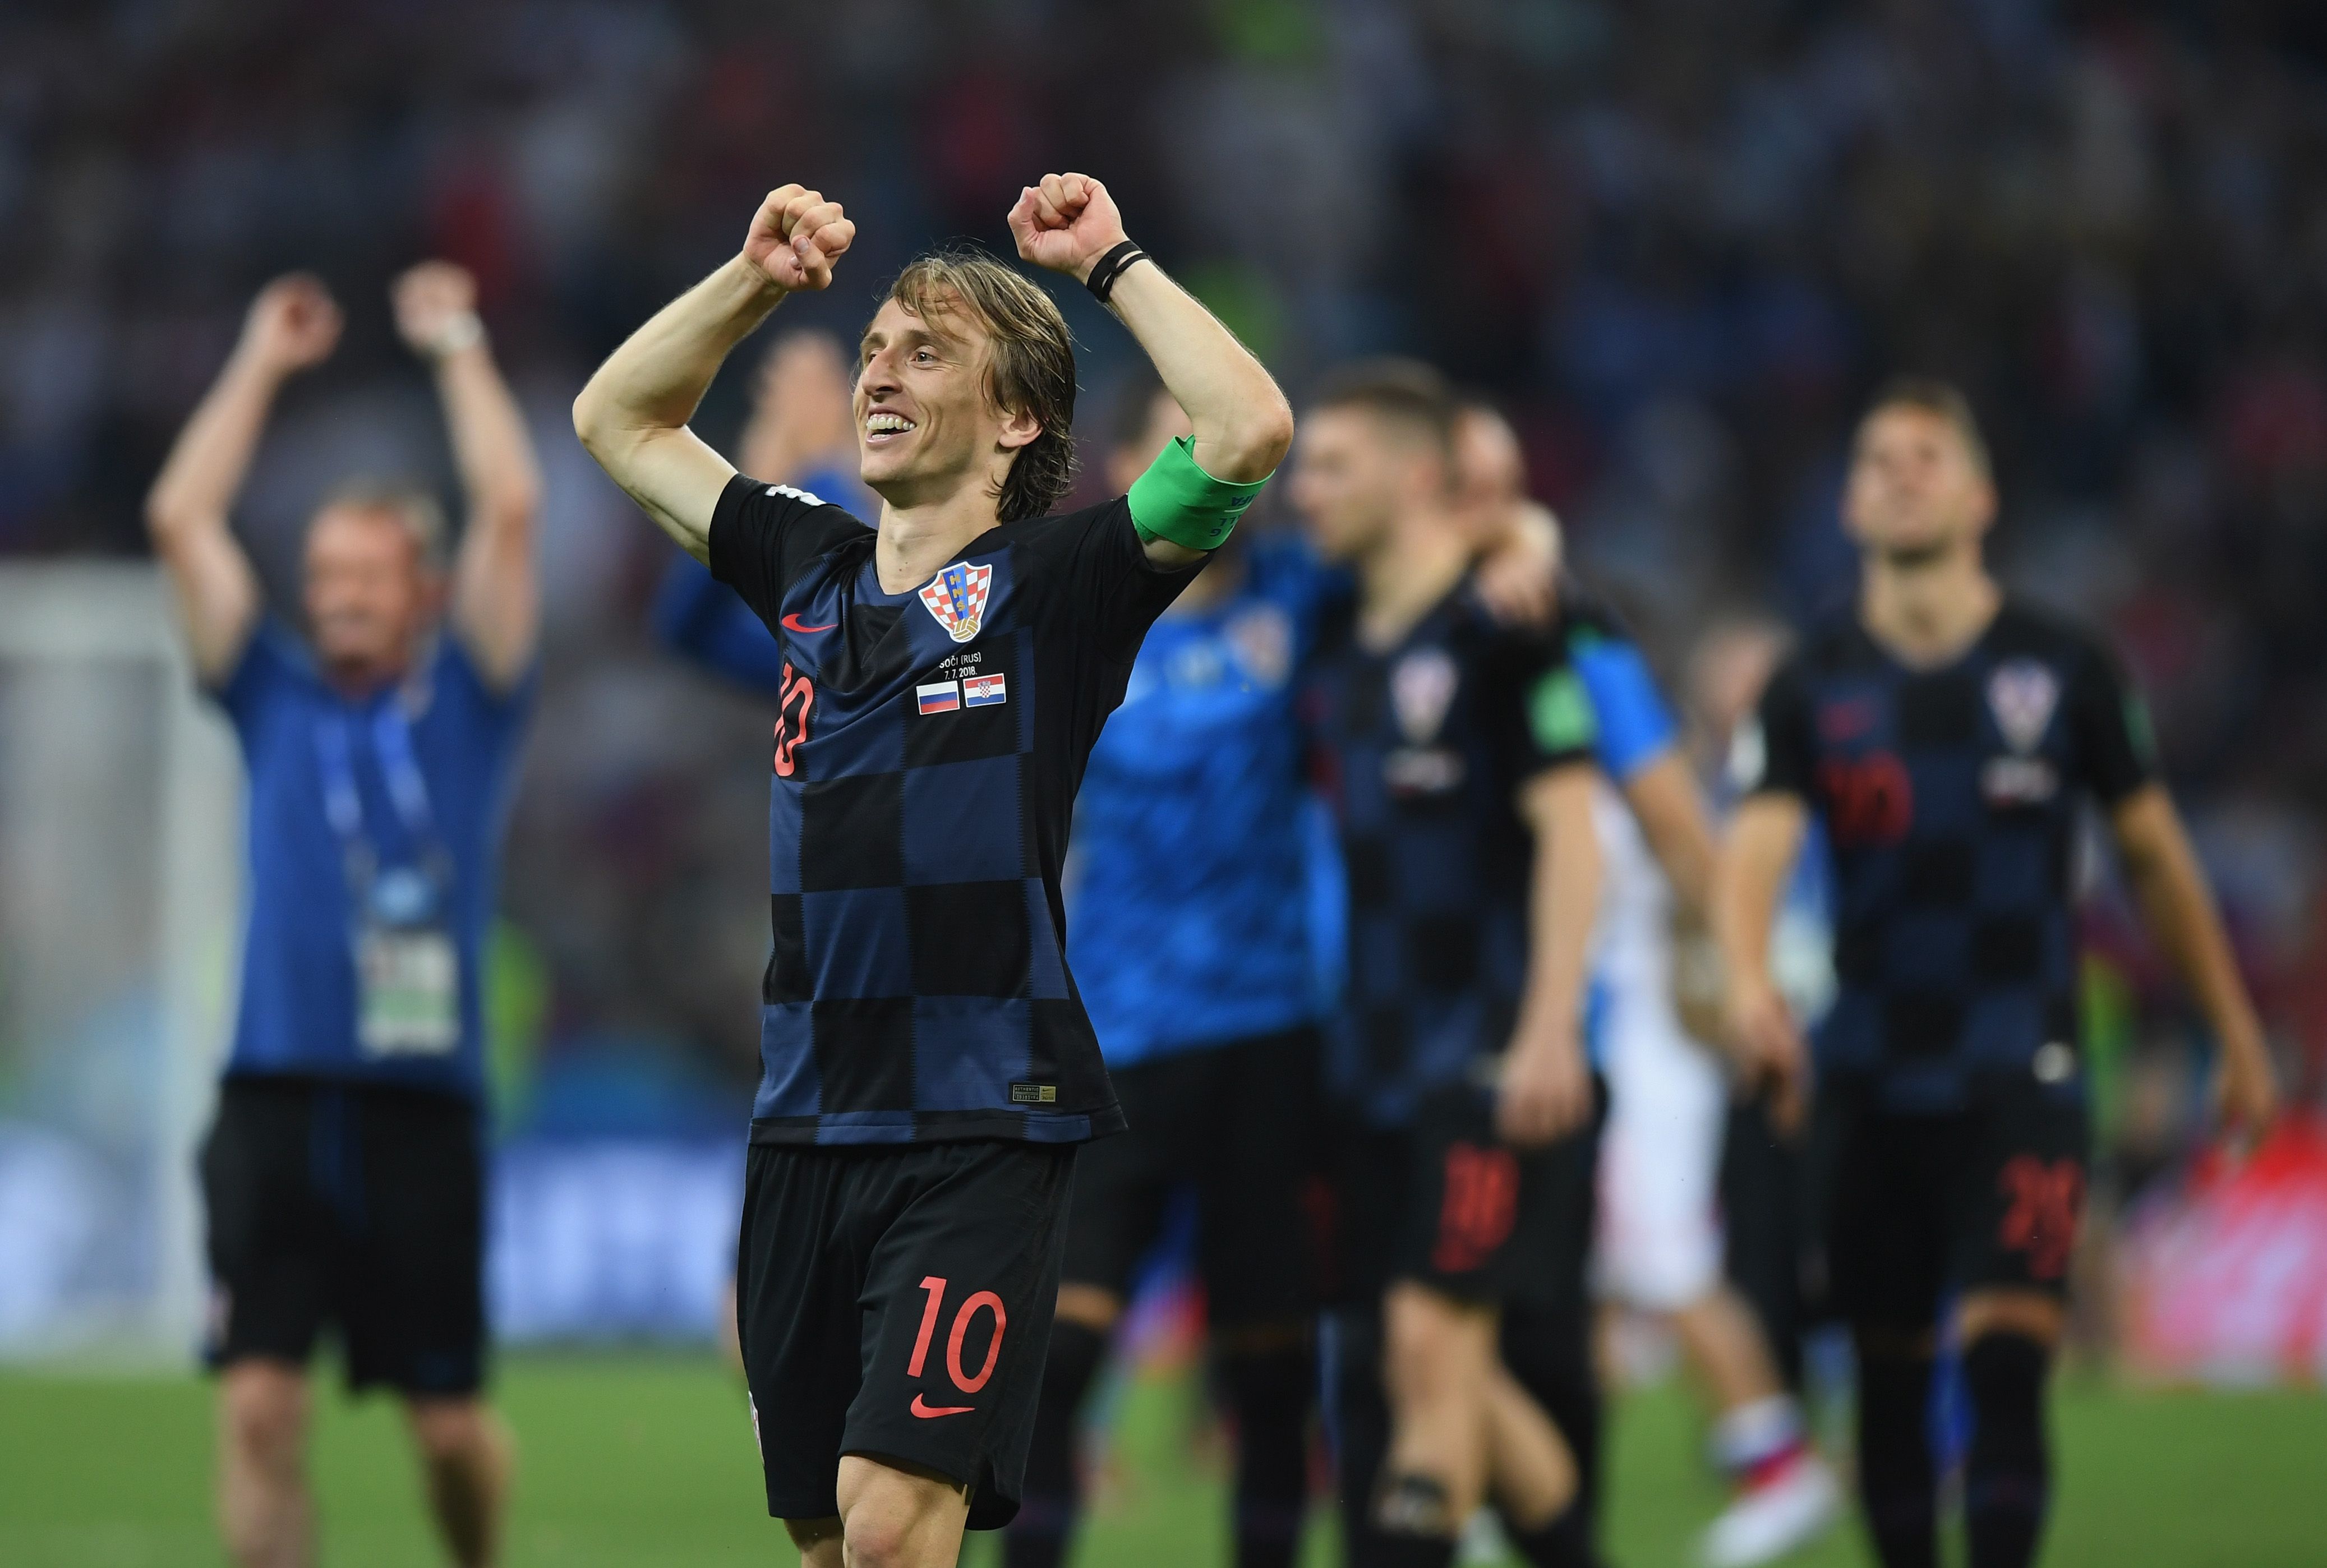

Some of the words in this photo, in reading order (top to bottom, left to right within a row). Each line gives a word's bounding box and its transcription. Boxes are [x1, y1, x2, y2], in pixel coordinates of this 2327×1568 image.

[950, 574, 965, 611] HNS
[939, 655, 959, 668] SOČI
[961, 651, 982, 665] (RUS)
[959, 666, 978, 677] 2018.
[774, 662, 813, 777] 10
[907, 1276, 1006, 1393] 10
